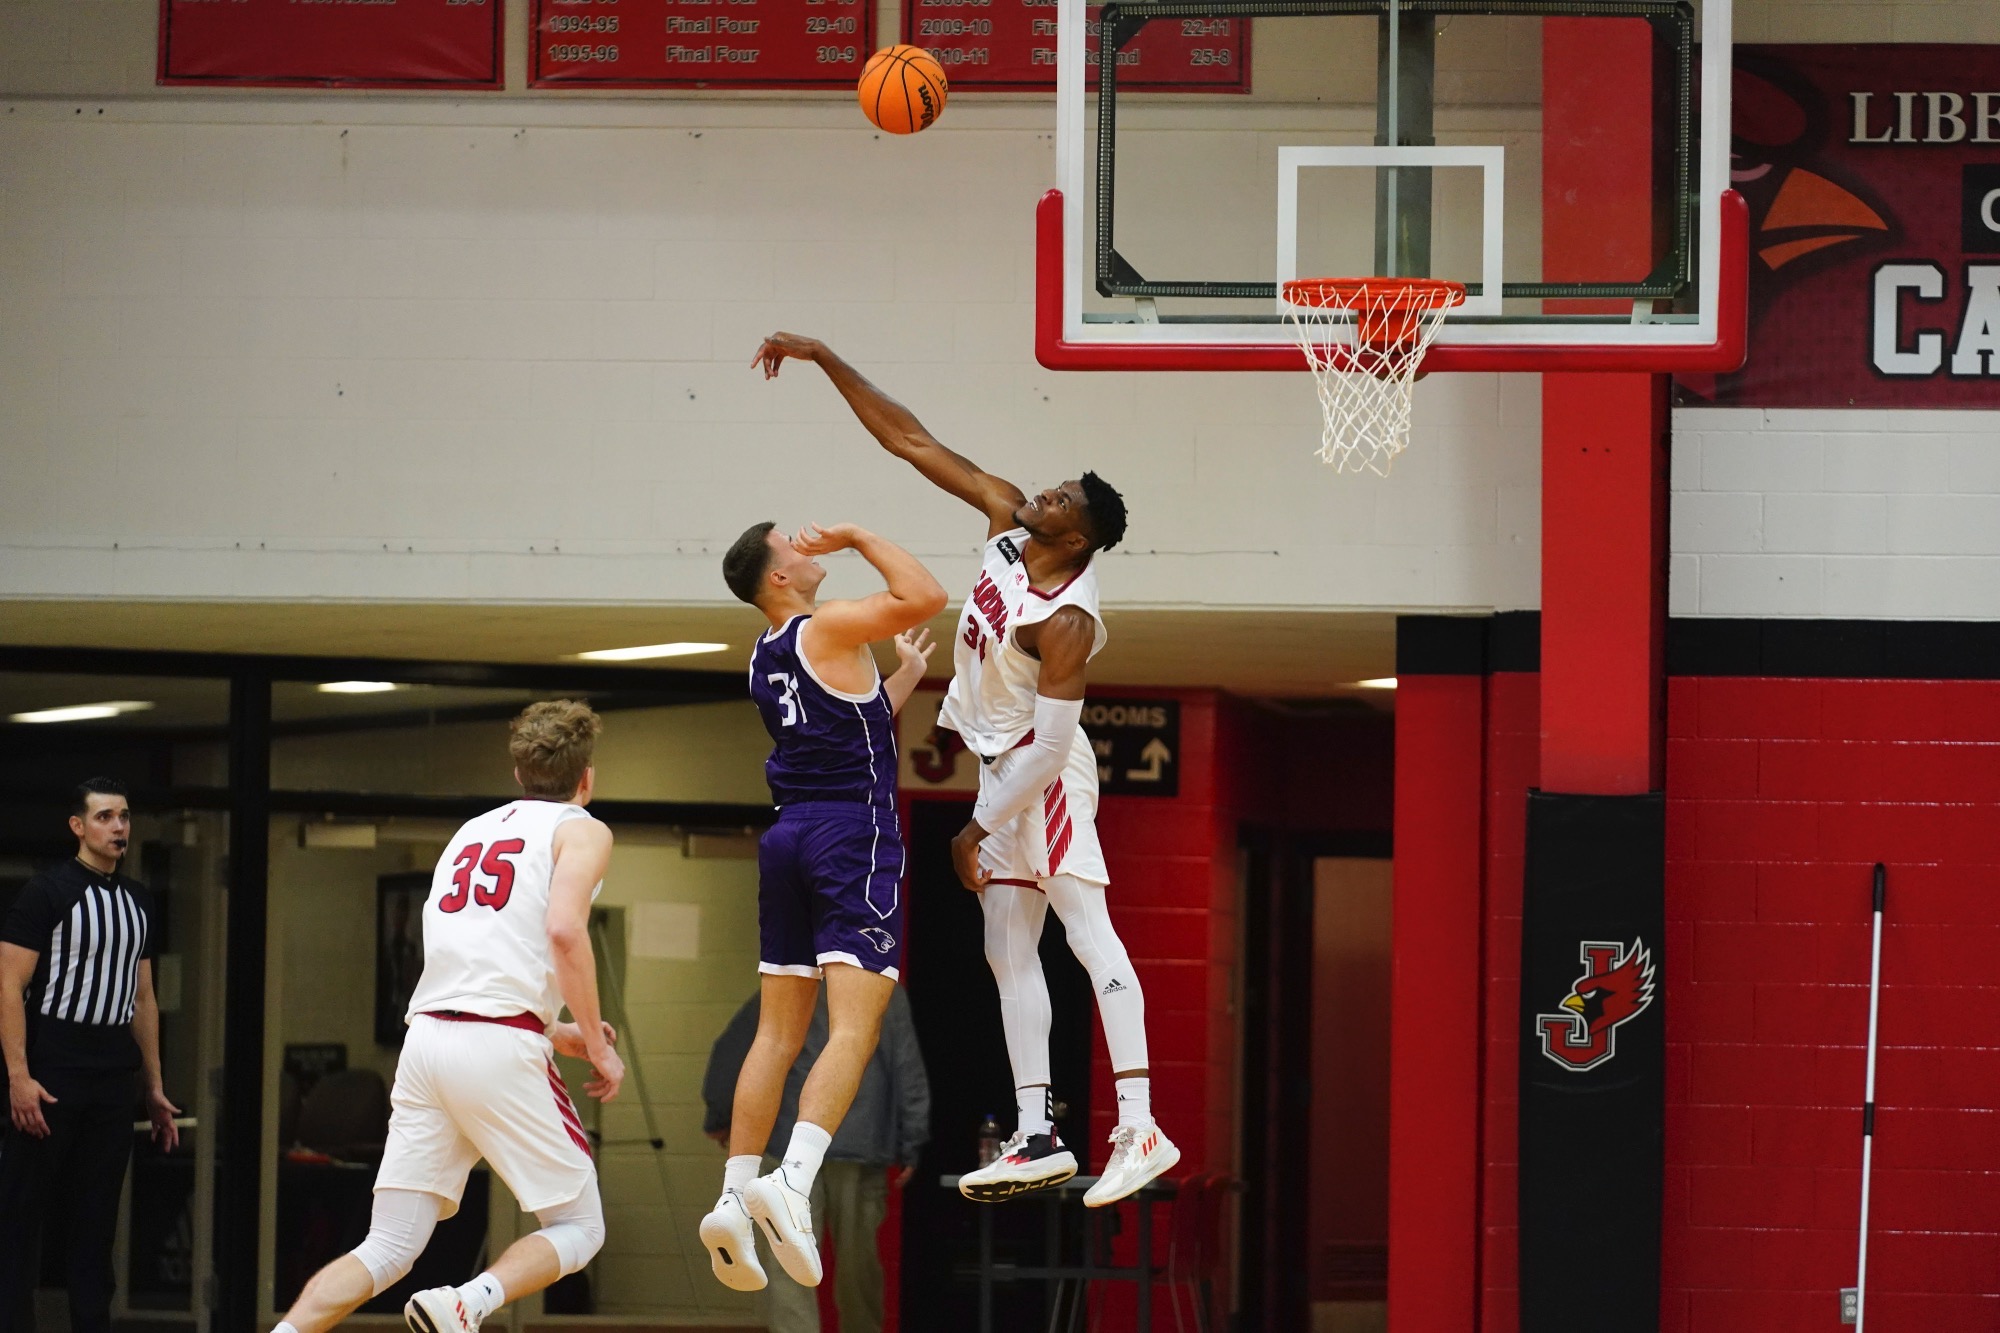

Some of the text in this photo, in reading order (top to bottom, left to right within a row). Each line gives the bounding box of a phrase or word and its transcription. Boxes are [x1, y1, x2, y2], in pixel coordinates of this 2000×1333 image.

[549, 16, 857, 34] 1994-95 Final Four 29-10
[920, 19, 992, 36] 2009-10
[1181, 19, 1231, 36] 22-11
[549, 45, 857, 63] 1995-96 Final Four 30-9
[926, 48, 989, 65] 010-11
[1085, 49, 1141, 65] Rond
[1190, 49, 1232, 65] 25-8
[917, 86, 936, 131] lson
[1849, 92, 2000, 142] LIBE
[766, 670, 808, 727] 31
[438, 837, 526, 914] 35
